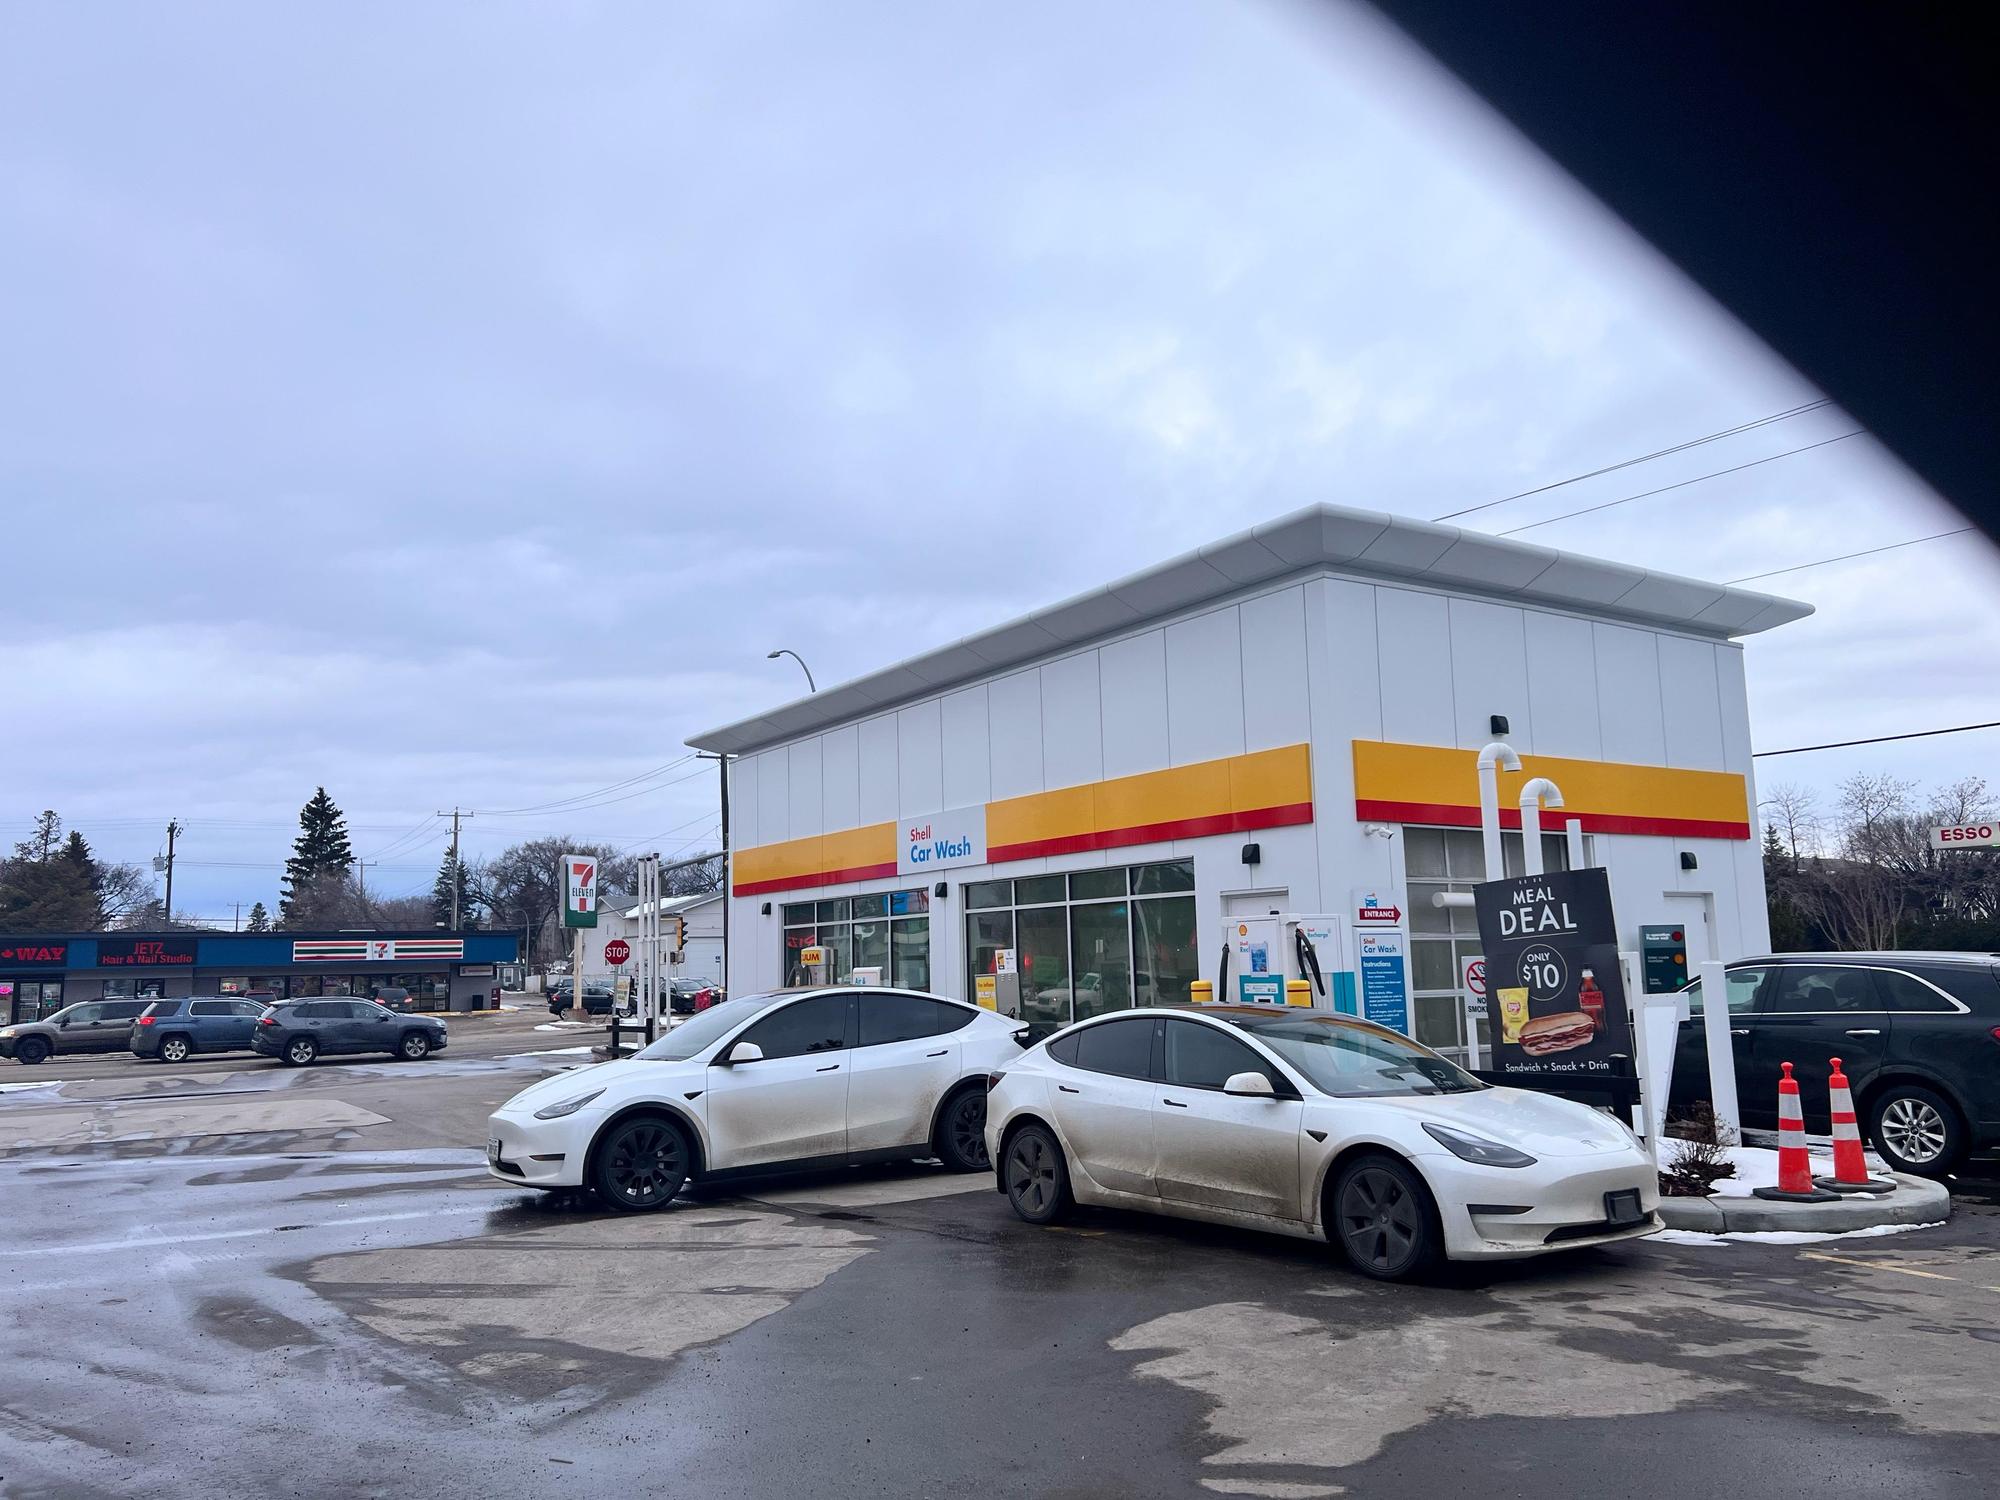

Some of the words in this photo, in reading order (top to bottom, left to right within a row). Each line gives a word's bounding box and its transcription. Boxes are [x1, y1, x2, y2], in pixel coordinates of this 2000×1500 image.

[910, 824, 931, 842] Shell
[1940, 826, 1992, 841] ESSO
[910, 845, 932, 863] Car
[935, 835, 971, 859] Wash
[573, 863, 594, 912] 7
[1513, 886, 1555, 905] MEAL
[1364, 910, 1395, 918] ENTRANCE
[1499, 902, 1578, 936] DEAL
[17, 947, 65, 961] WAY
[606, 947, 629, 958] STOP
[1363, 945, 1376, 953] Car
[1377, 944, 1397, 953] Wash
[102, 955, 125, 964] Hair
[127, 955, 134, 964] &
[138, 954, 157, 964] Nail
[160, 953, 193, 963] Studio
[1527, 952, 1550, 963] ONLY
[1523, 963, 1560, 989] $10
[1505, 1063, 1541, 1073] Sandwich
[1550, 1061, 1577, 1071] Snack
[1588, 1060, 1609, 1070] Drin
